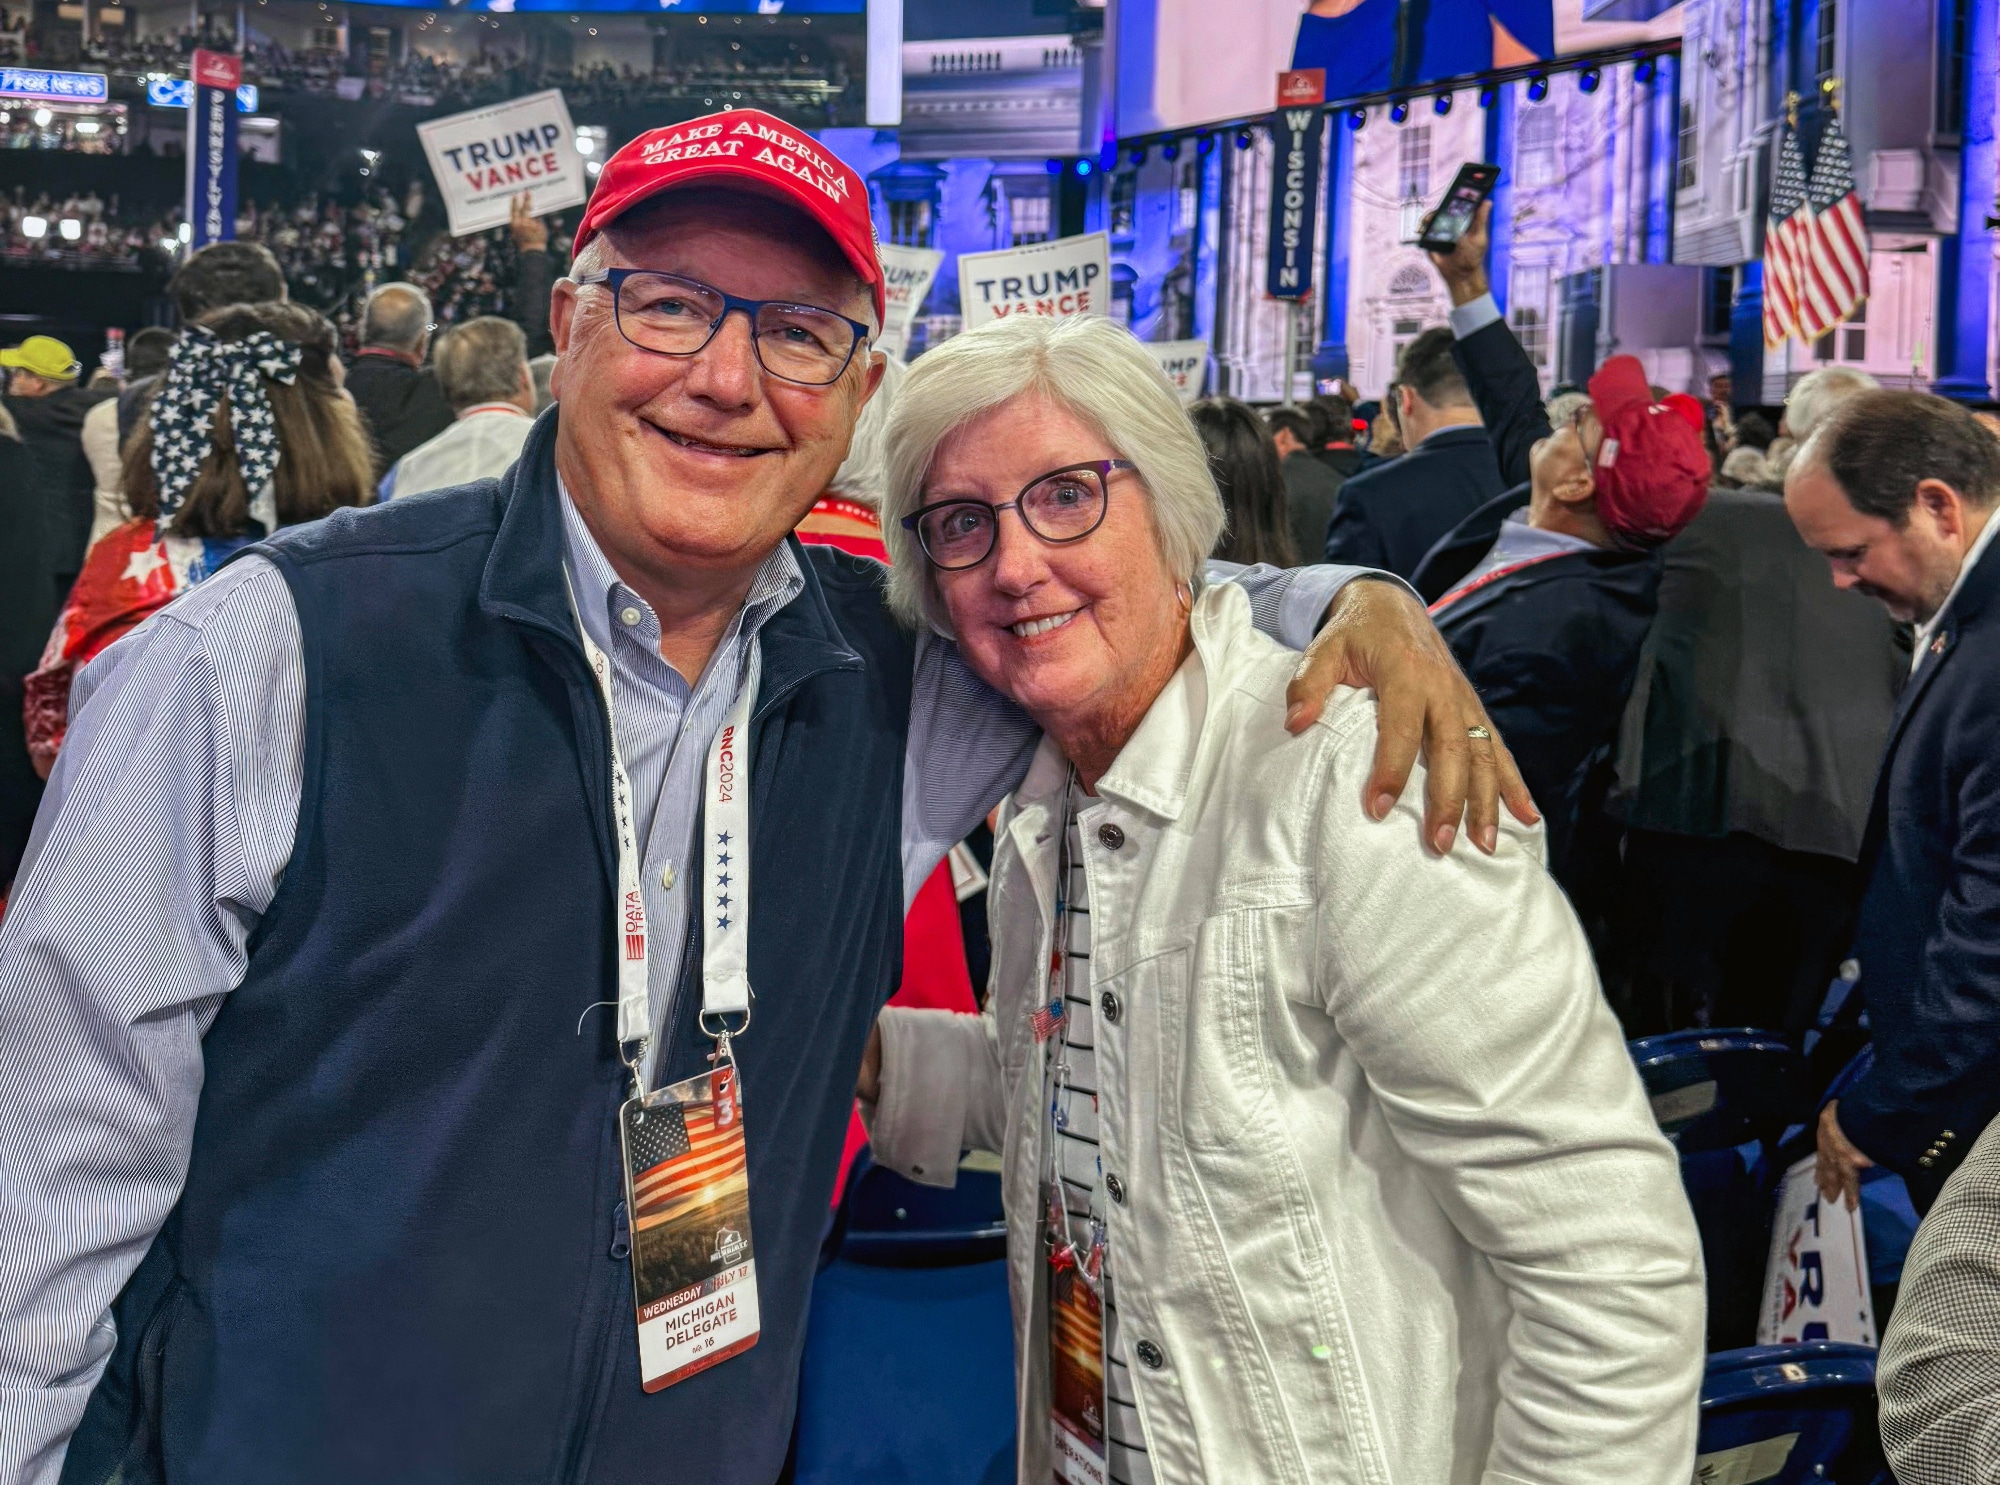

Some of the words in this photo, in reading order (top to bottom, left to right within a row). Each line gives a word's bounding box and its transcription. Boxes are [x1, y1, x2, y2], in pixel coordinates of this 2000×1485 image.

[442, 123, 560, 172] TRUMP
[466, 152, 559, 192] VANCE
[641, 123, 724, 157] MAKE
[730, 121, 850, 198] AMERICA
[645, 140, 744, 165] GREAT
[752, 147, 841, 204] AGAIN
[1279, 110, 1313, 288] WISCONSIN
[975, 262, 1099, 303] TRUMP
[719, 725, 735, 803] RNC2024
[643, 1285, 702, 1319] WEDNESDAY
[738, 1265, 748, 1278] 17
[1781, 1224, 1803, 1342] VA
[665, 1292, 735, 1334] MICHIGAN
[666, 1308, 738, 1351] DELEGATE
